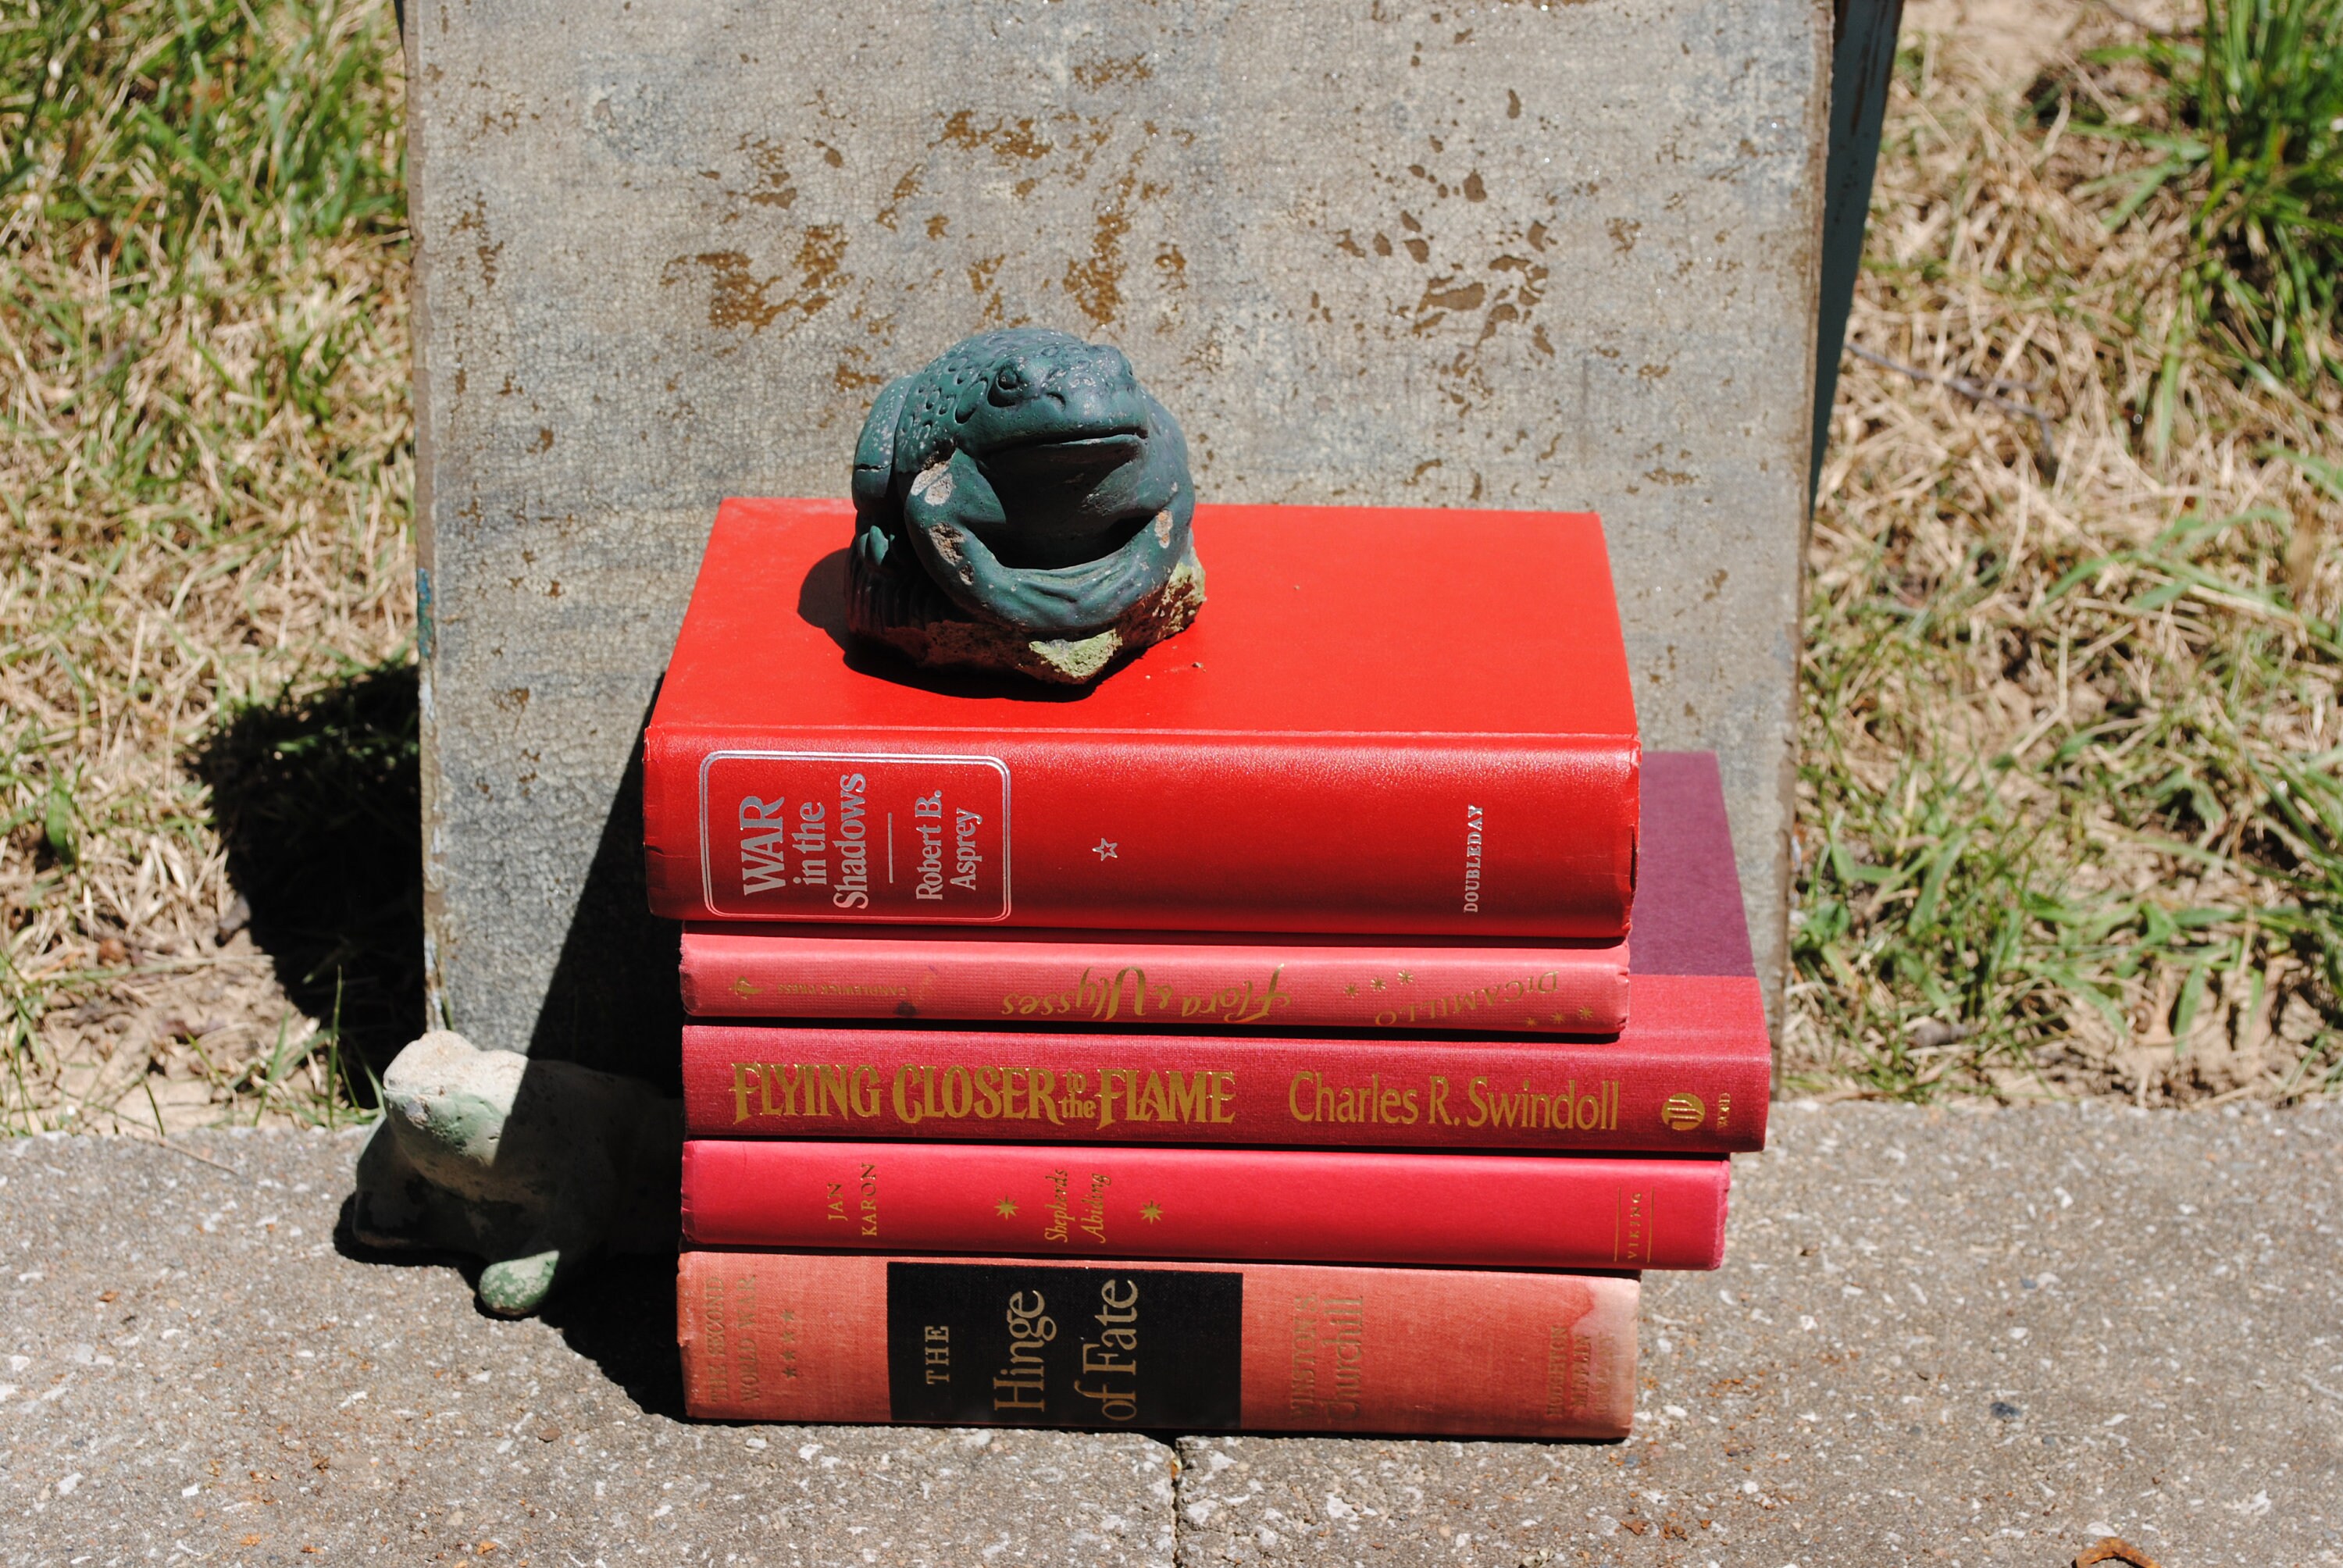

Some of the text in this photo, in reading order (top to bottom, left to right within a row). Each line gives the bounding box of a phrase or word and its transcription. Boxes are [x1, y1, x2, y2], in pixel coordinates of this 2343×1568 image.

[739, 795, 787, 896] WAR
[792, 801, 827, 886] in the
[833, 772, 870, 909] Shadows
[915, 789, 944, 900] Robert B.
[950, 807, 983, 890] Asprey
[1464, 804, 1483, 913] DOUBLEDAY
[778, 983, 818, 995] PRESS
[1000, 963, 1291, 1023] Flora & Ulysses
[728, 1060, 1236, 1131] FLYING CLOSER to the FLAME
[1289, 1071, 1620, 1131] Charles R. Swindoll
[827, 1181, 848, 1221] JAN
[861, 1162, 877, 1237] KARON
[1044, 1168, 1075, 1243] Shepherds
[1080, 1173, 1111, 1244] Abiding
[1627, 1192, 1642, 1260] VIKING
[705, 1276, 729, 1403] THE SECOND
[736, 1274, 761, 1402] WORLD WAR
[925, 1325, 950, 1384] THE
[993, 1289, 1057, 1413] Hinge
[1074, 1278, 1139, 1421] of Fate
[1291, 1317, 1317, 1421] WINSTON
[1319, 1295, 1364, 1421] Churchill
